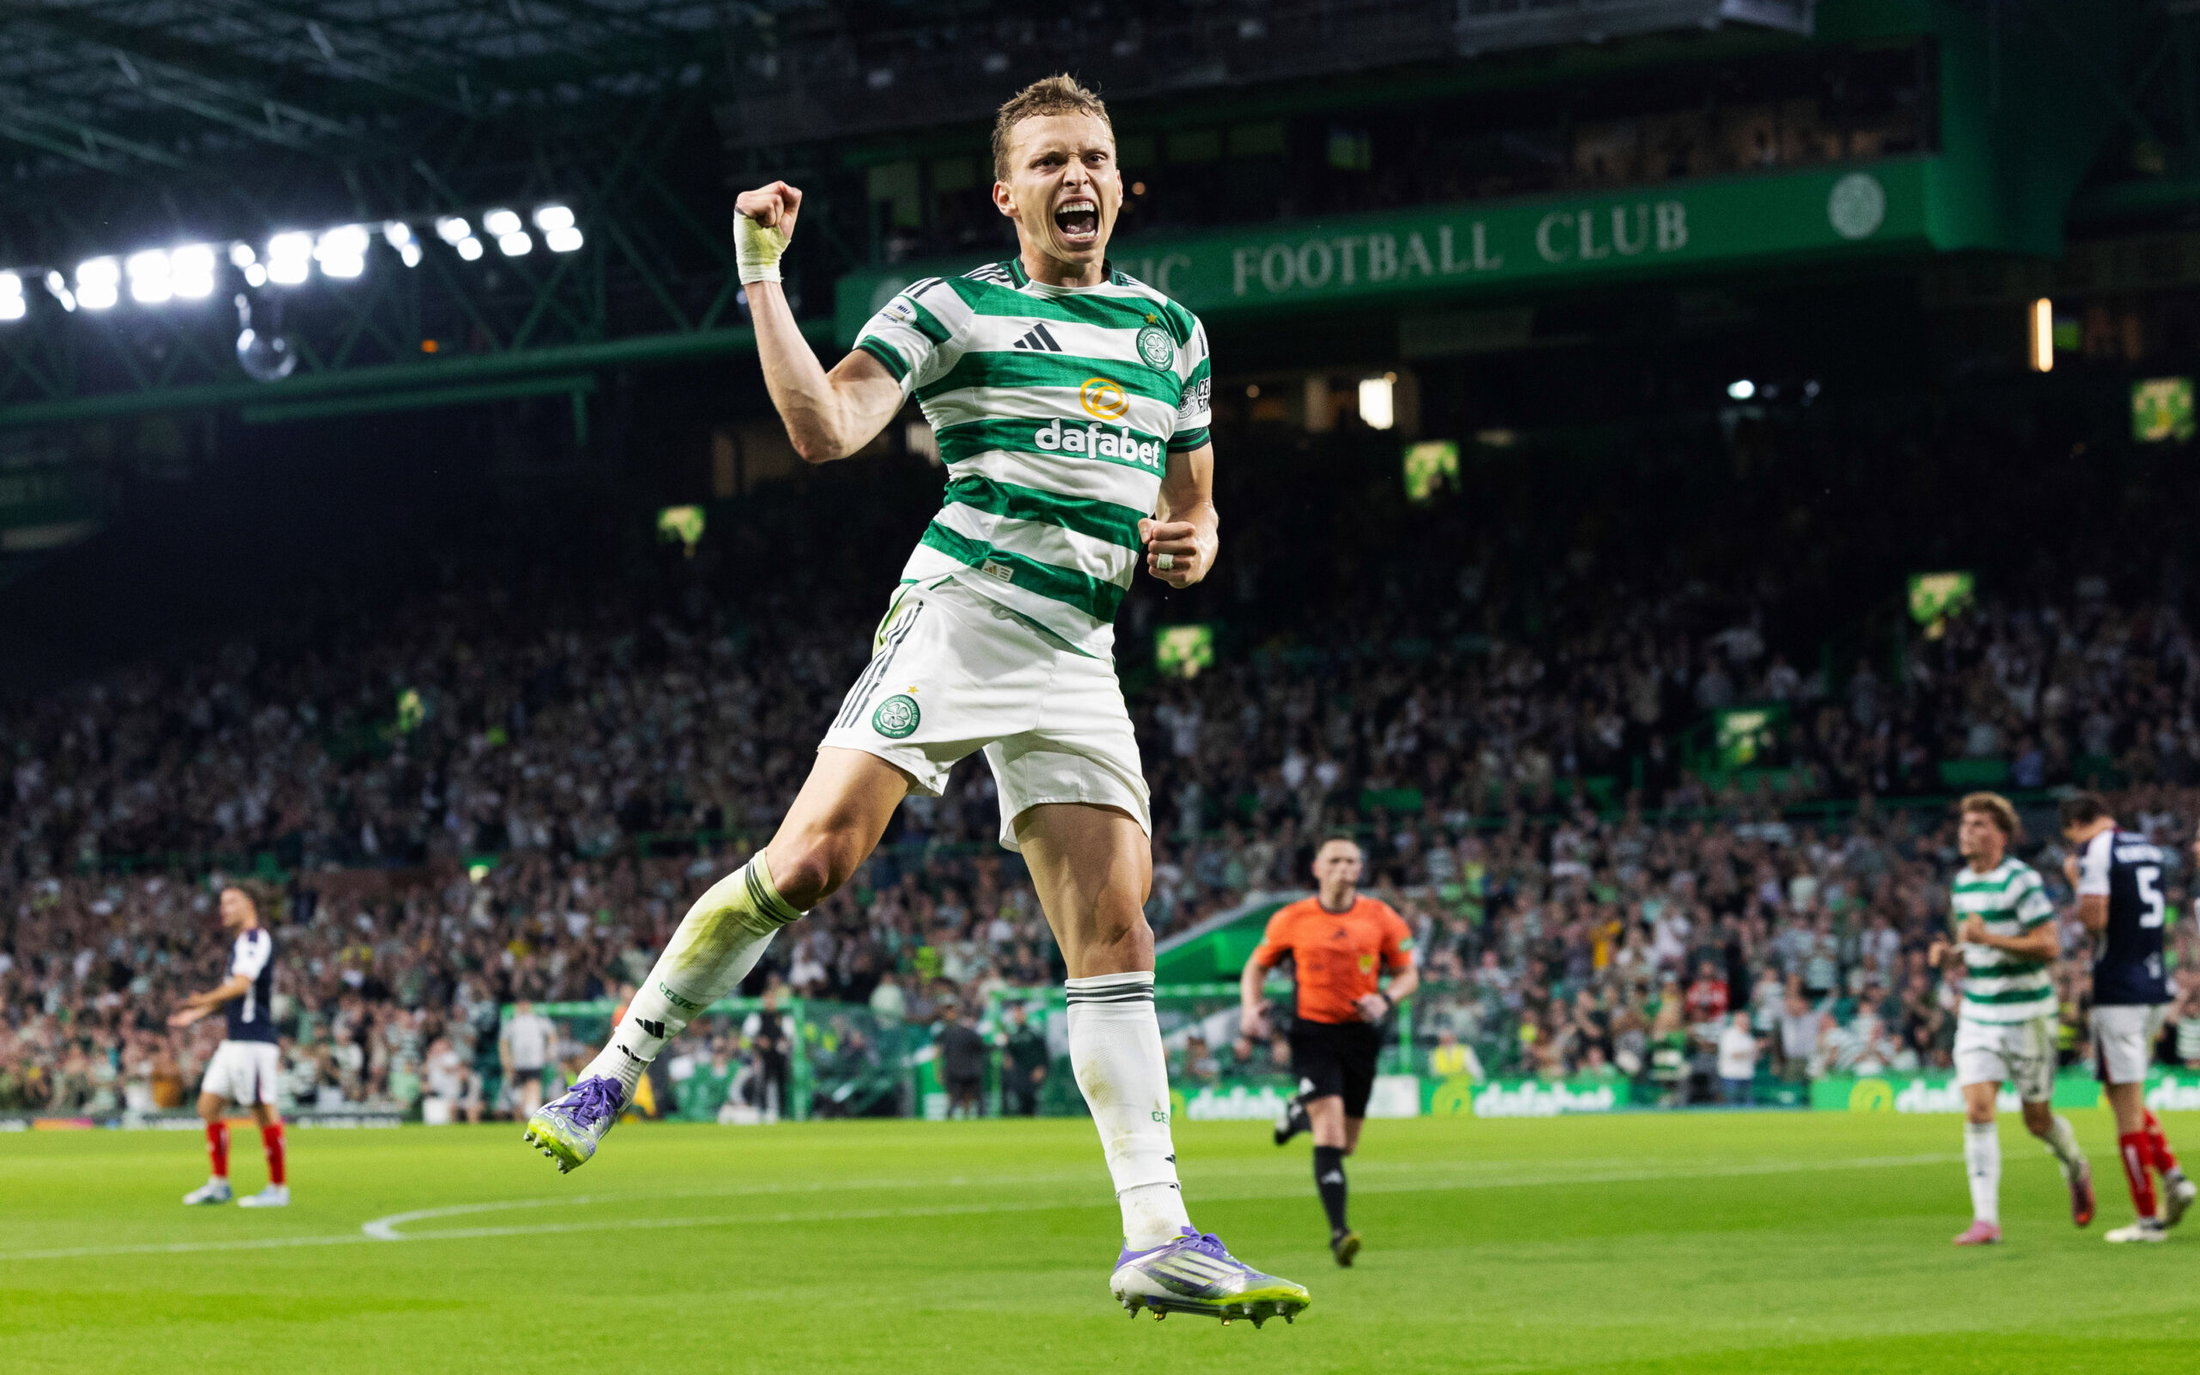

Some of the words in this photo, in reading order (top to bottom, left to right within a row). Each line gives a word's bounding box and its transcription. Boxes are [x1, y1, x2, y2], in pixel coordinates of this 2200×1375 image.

[1233, 221, 1502, 296] FOOTBALL
[1535, 201, 1689, 264] CLUB
[1034, 417, 1159, 470] dafabet
[2135, 866, 2165, 928] 5
